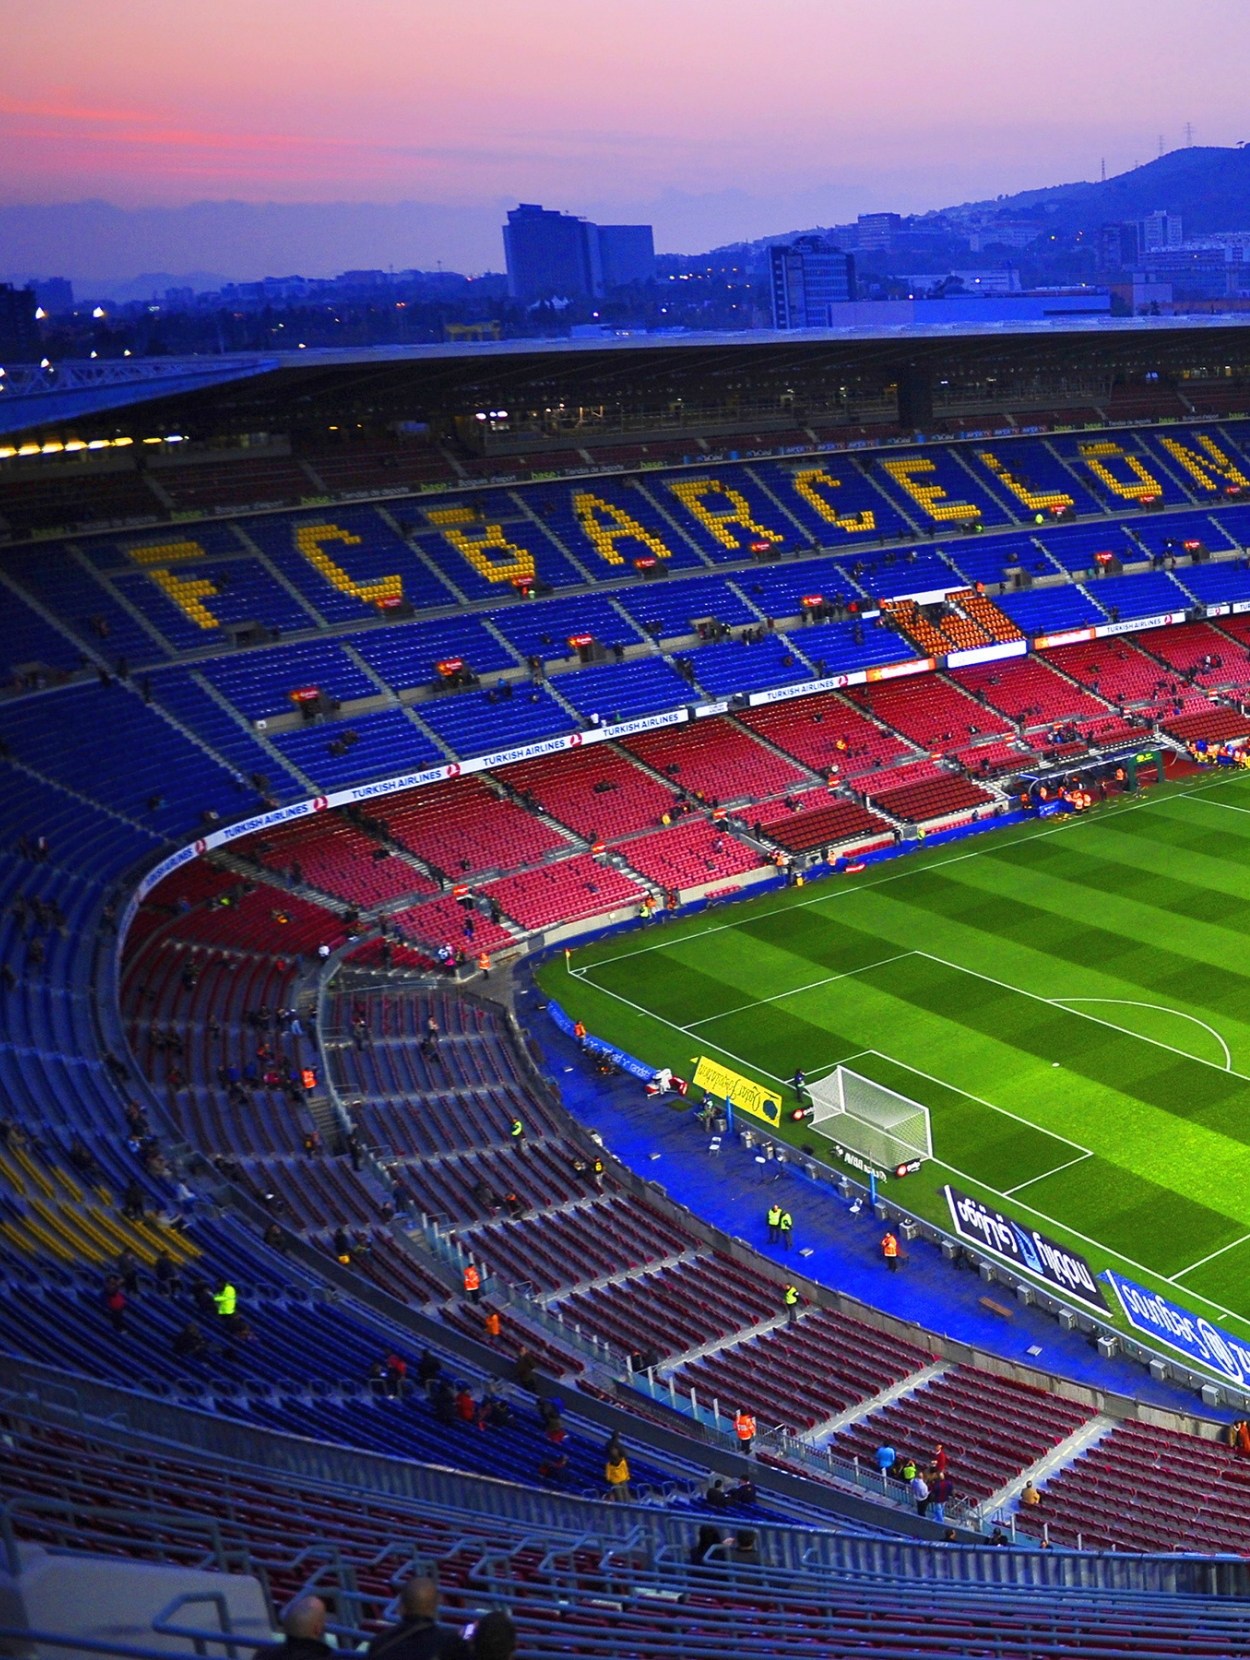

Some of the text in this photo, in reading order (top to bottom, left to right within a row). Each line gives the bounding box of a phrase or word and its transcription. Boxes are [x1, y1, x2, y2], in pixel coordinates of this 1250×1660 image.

[1107, 617, 1162, 633] TURKISH AIRLINES
[767, 679, 834, 701] TURKISH AIRLINES
[603, 713, 679, 737] TURKISH AIRLINES
[483, 739, 565, 767] TURKISH AIRLINES
[352, 770, 442, 799] TURKISH AIRLINES
[224, 804, 309, 840] TURKISH AIRLINES
[740, 1086, 761, 1112] Qatar
[1032, 1231, 1097, 1293] mobily
[1121, 1284, 1210, 1359] Seguros
